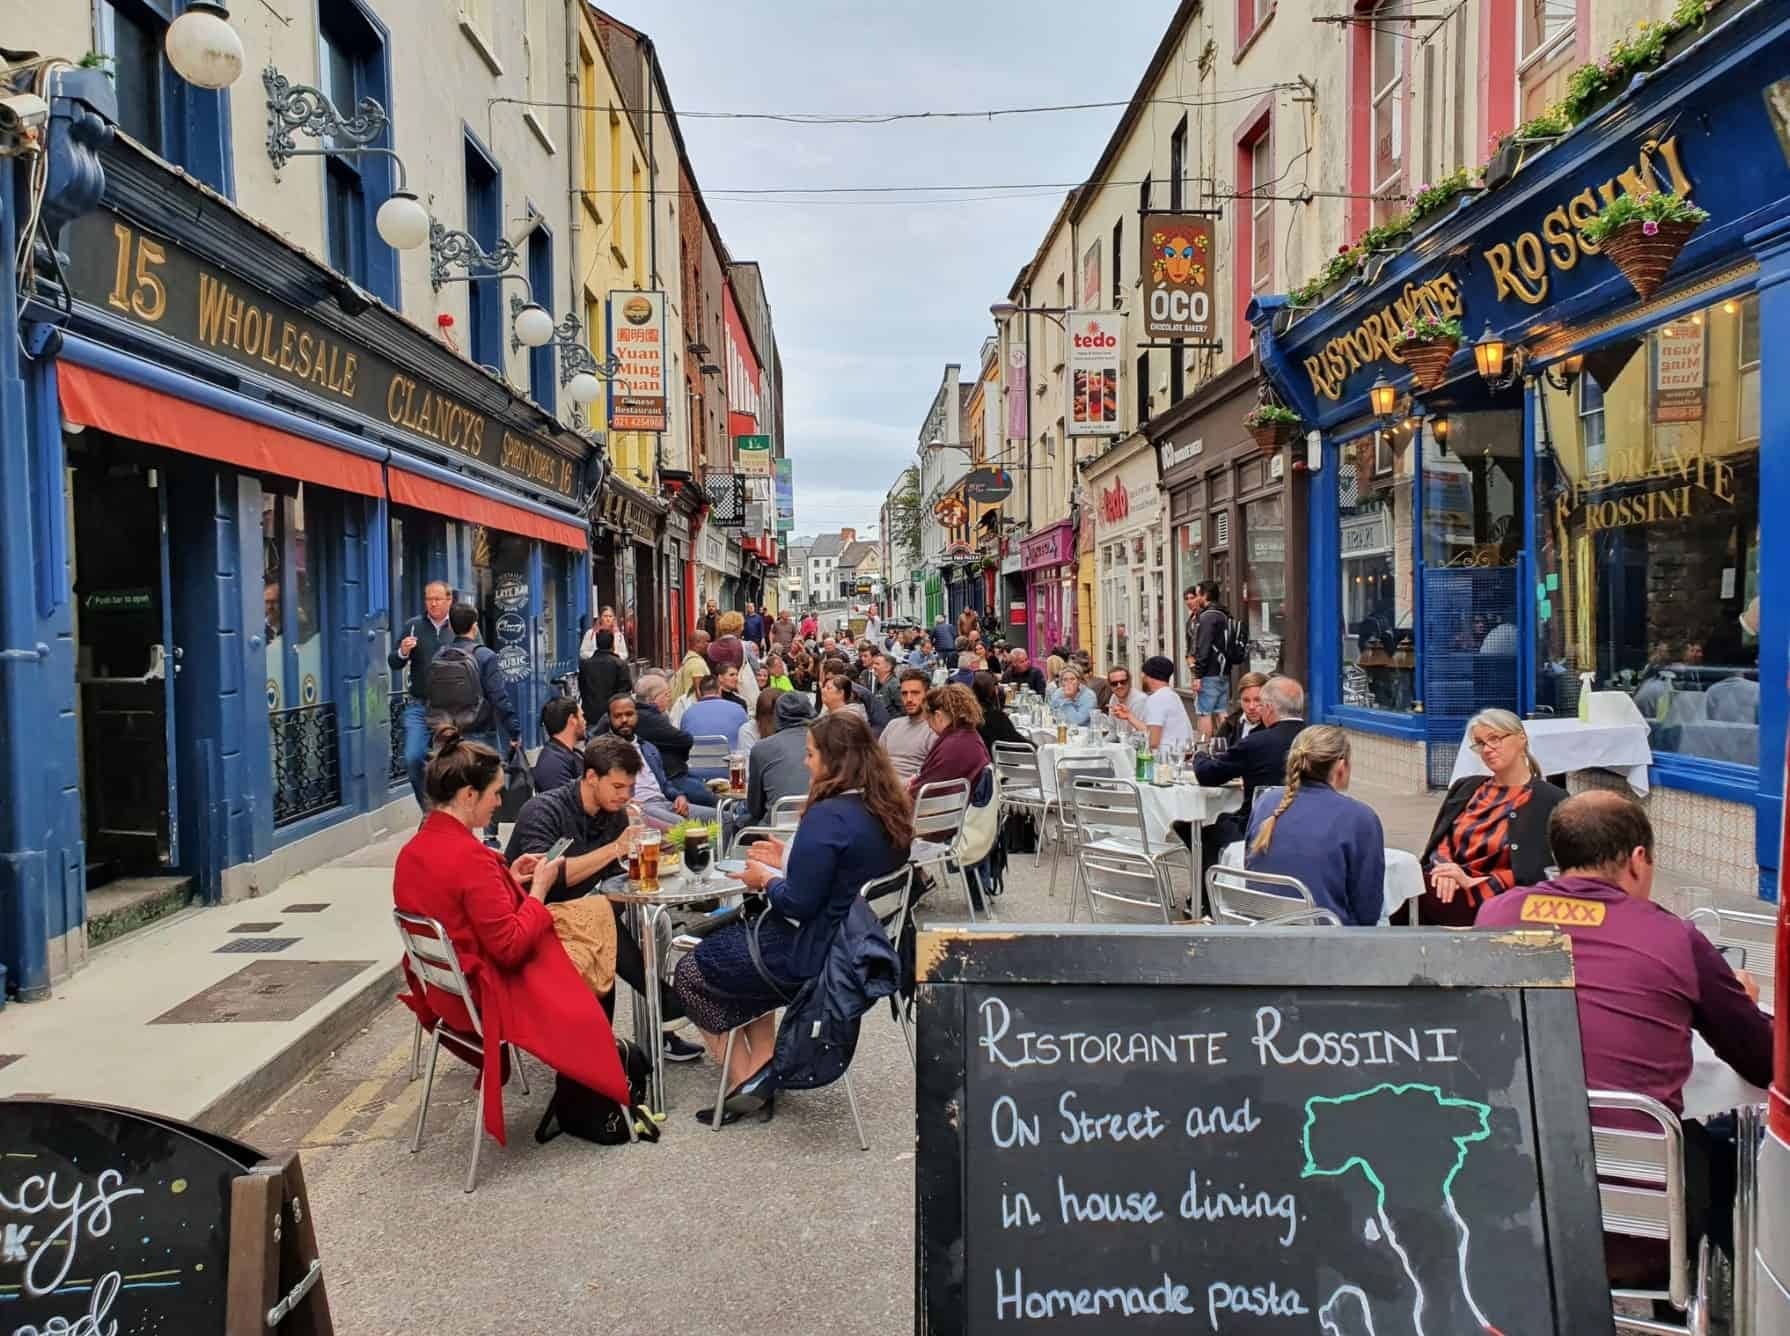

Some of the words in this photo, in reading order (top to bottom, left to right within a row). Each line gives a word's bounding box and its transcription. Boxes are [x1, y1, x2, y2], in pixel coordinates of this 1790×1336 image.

[1151, 281, 1208, 322] ÓCO
[1074, 332, 1116, 348] tedo
[1150, 323, 1184, 332] CHOCOLATE
[1184, 324, 1208, 333] BAKERY
[109, 223, 166, 320] 15
[199, 272, 358, 397] WHOLESALE
[388, 373, 485, 456] CLANCYS
[559, 458, 573, 494] 16
[616, 347, 659, 359] Yuan
[617, 363, 660, 378] Ming
[615, 406, 662, 415] Restaurant
[735, 478, 743, 515] NASH
[1555, 447, 1736, 526] RIORANTE
[1585, 486, 1693, 528] ROSSINI
[499, 655, 529, 669] MUSIC
[1526, 900, 1598, 922] XXXX
[979, 997, 1228, 1067] RISTORANTE
[1251, 1006, 1459, 1066] ROSSINI
[1058, 1090, 1165, 1146] Street
[1186, 1098, 1262, 1138] and
[1002, 1181, 1041, 1229] in
[1058, 1176, 1164, 1225] house
[1180, 1169, 1307, 1248] dining.
[0, 1169, 144, 1295] cys
[996, 1267, 1195, 1319] Homemade
[1207, 1281, 1309, 1331] pasta
